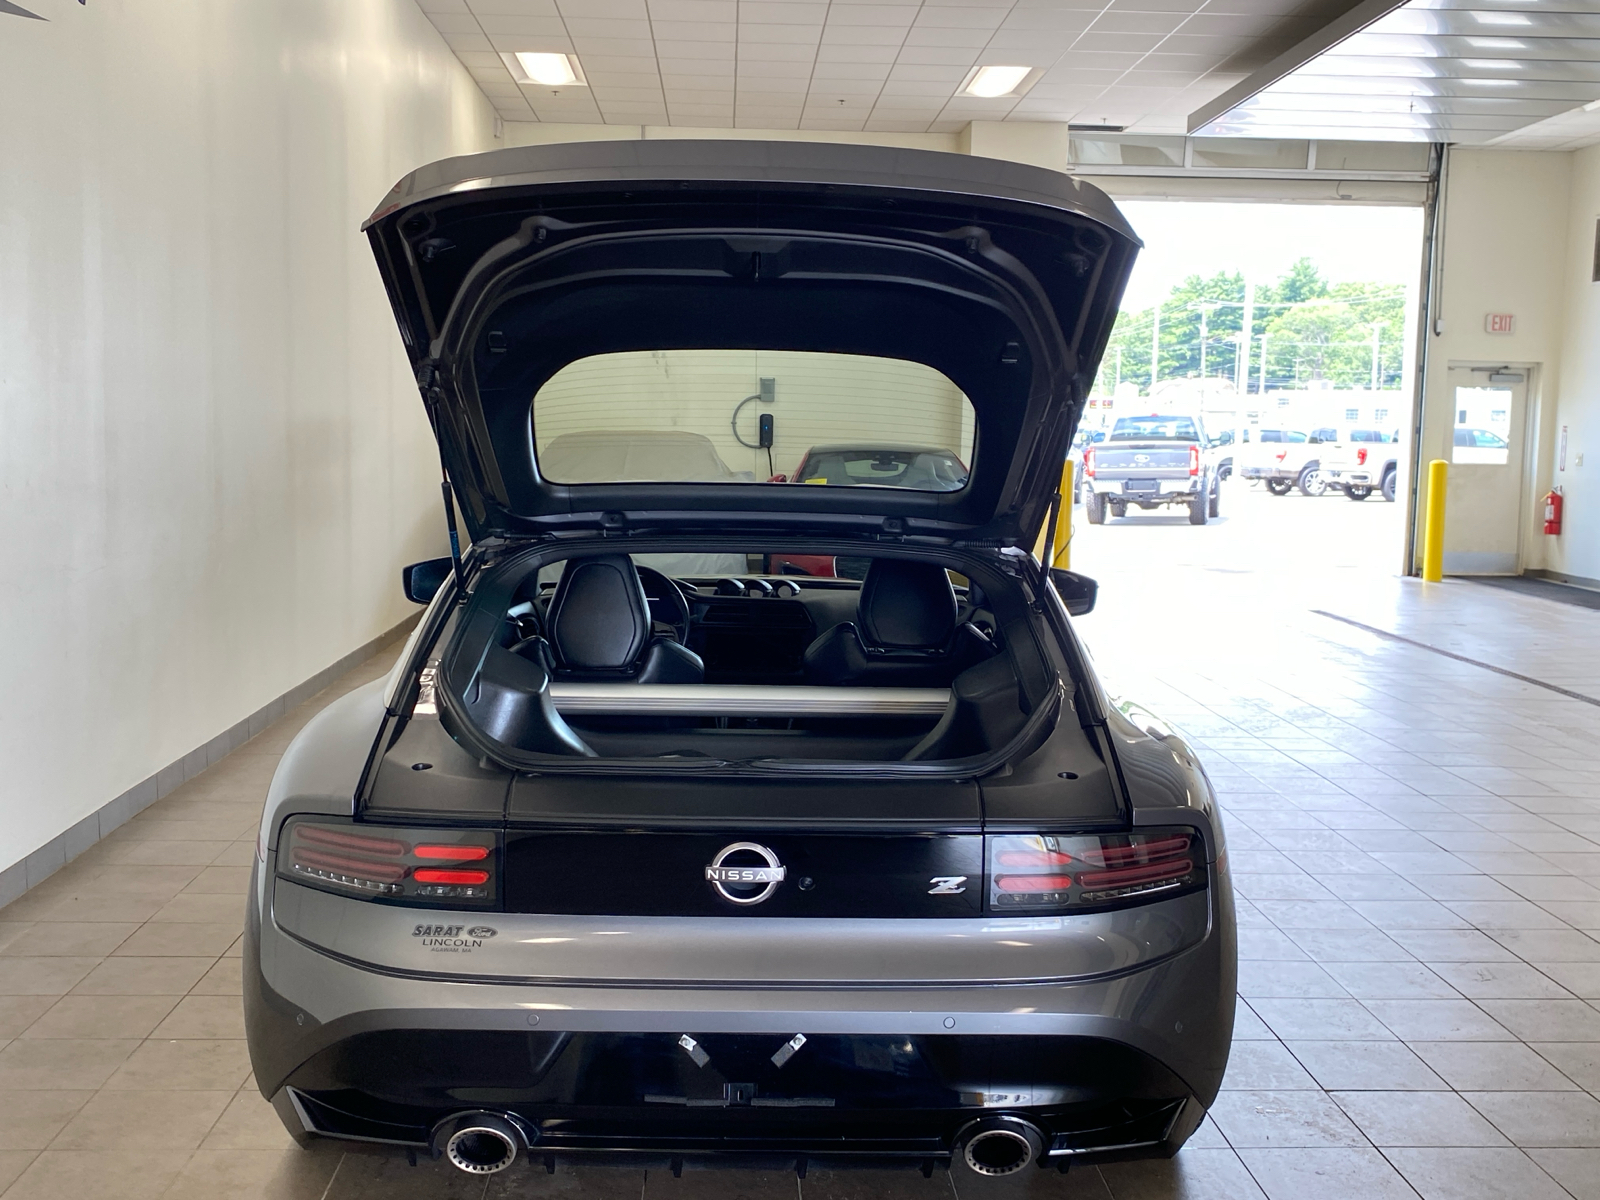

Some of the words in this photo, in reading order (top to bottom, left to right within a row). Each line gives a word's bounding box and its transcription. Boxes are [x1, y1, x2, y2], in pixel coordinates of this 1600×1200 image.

[1492, 314, 1513, 331] EXIT
[707, 869, 781, 881] NISSAN
[927, 876, 967, 894] Z
[412, 924, 464, 937] SARAT
[470, 926, 495, 938] Ford
[422, 939, 482, 947] LINCOLN
